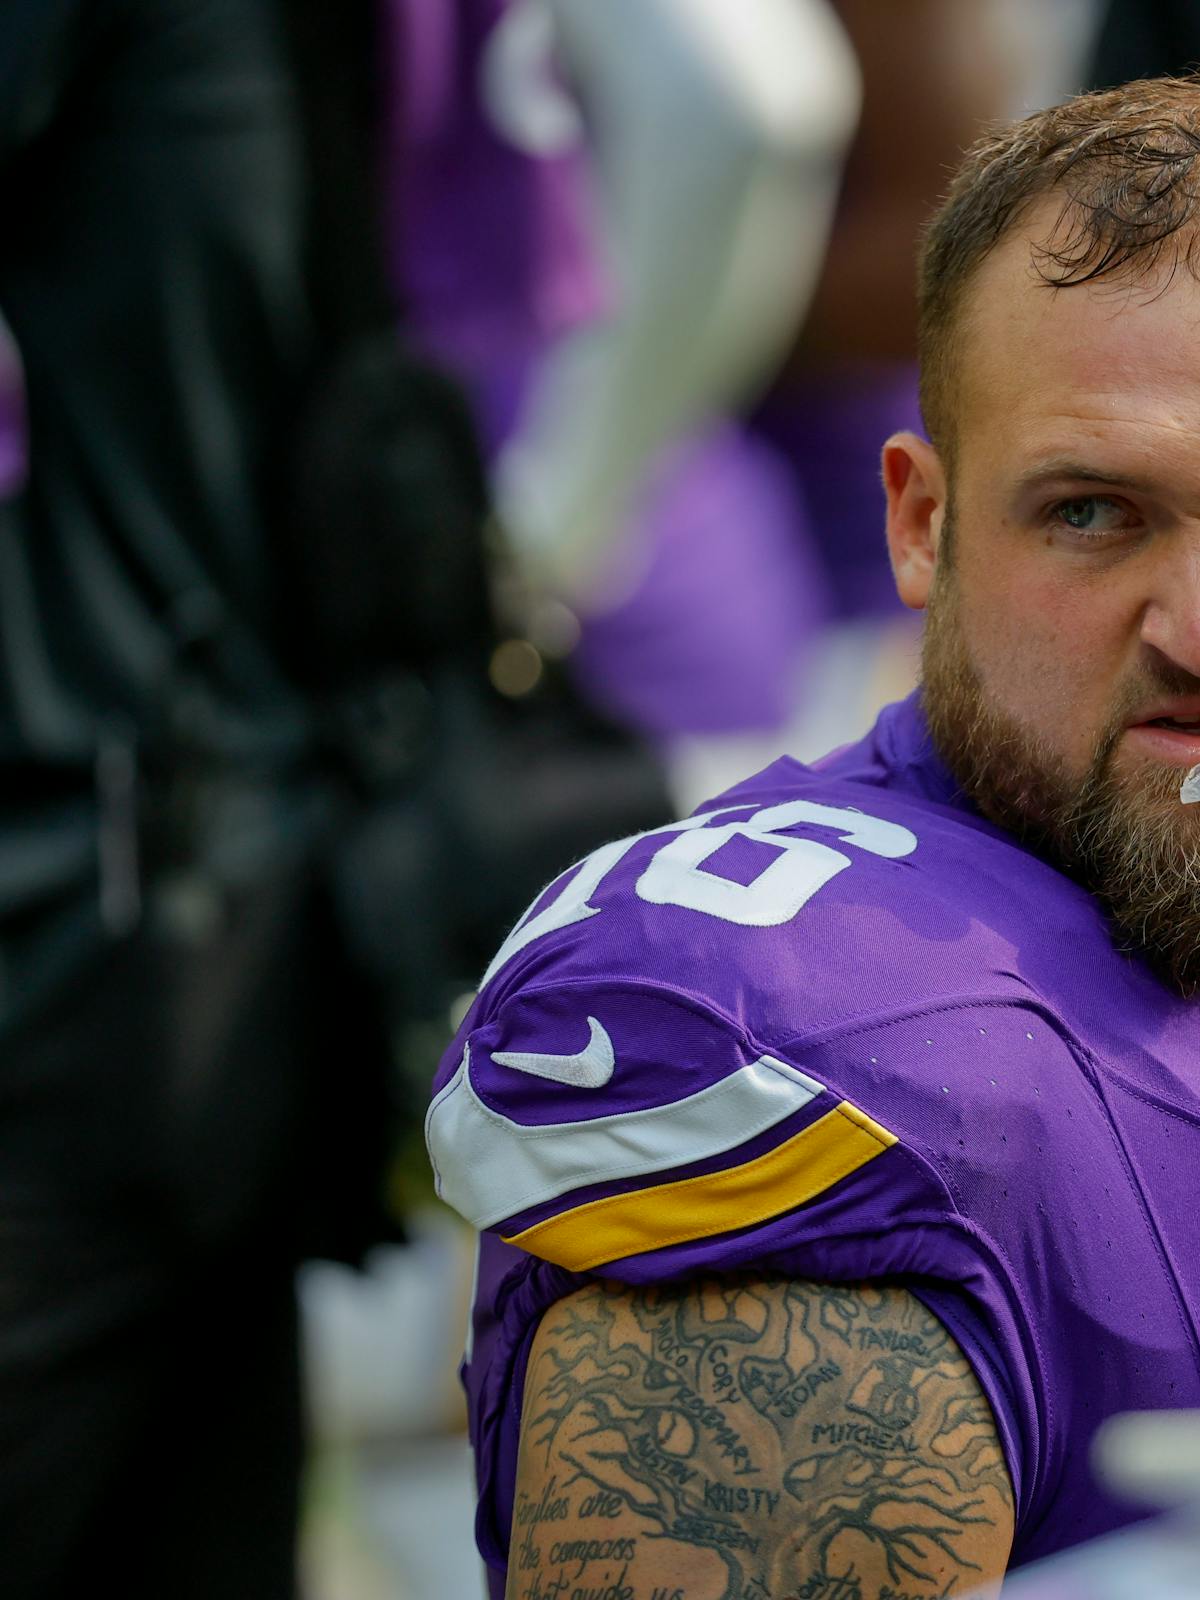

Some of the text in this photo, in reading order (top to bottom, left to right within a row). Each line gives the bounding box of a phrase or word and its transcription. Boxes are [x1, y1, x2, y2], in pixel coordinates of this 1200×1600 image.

[856, 1326, 929, 1356] TAYLOR
[707, 1343, 742, 1404] CORY
[578, 1490, 623, 1519] are
[704, 1479, 780, 1516] KRISTY
[549, 1536, 637, 1580] compass
